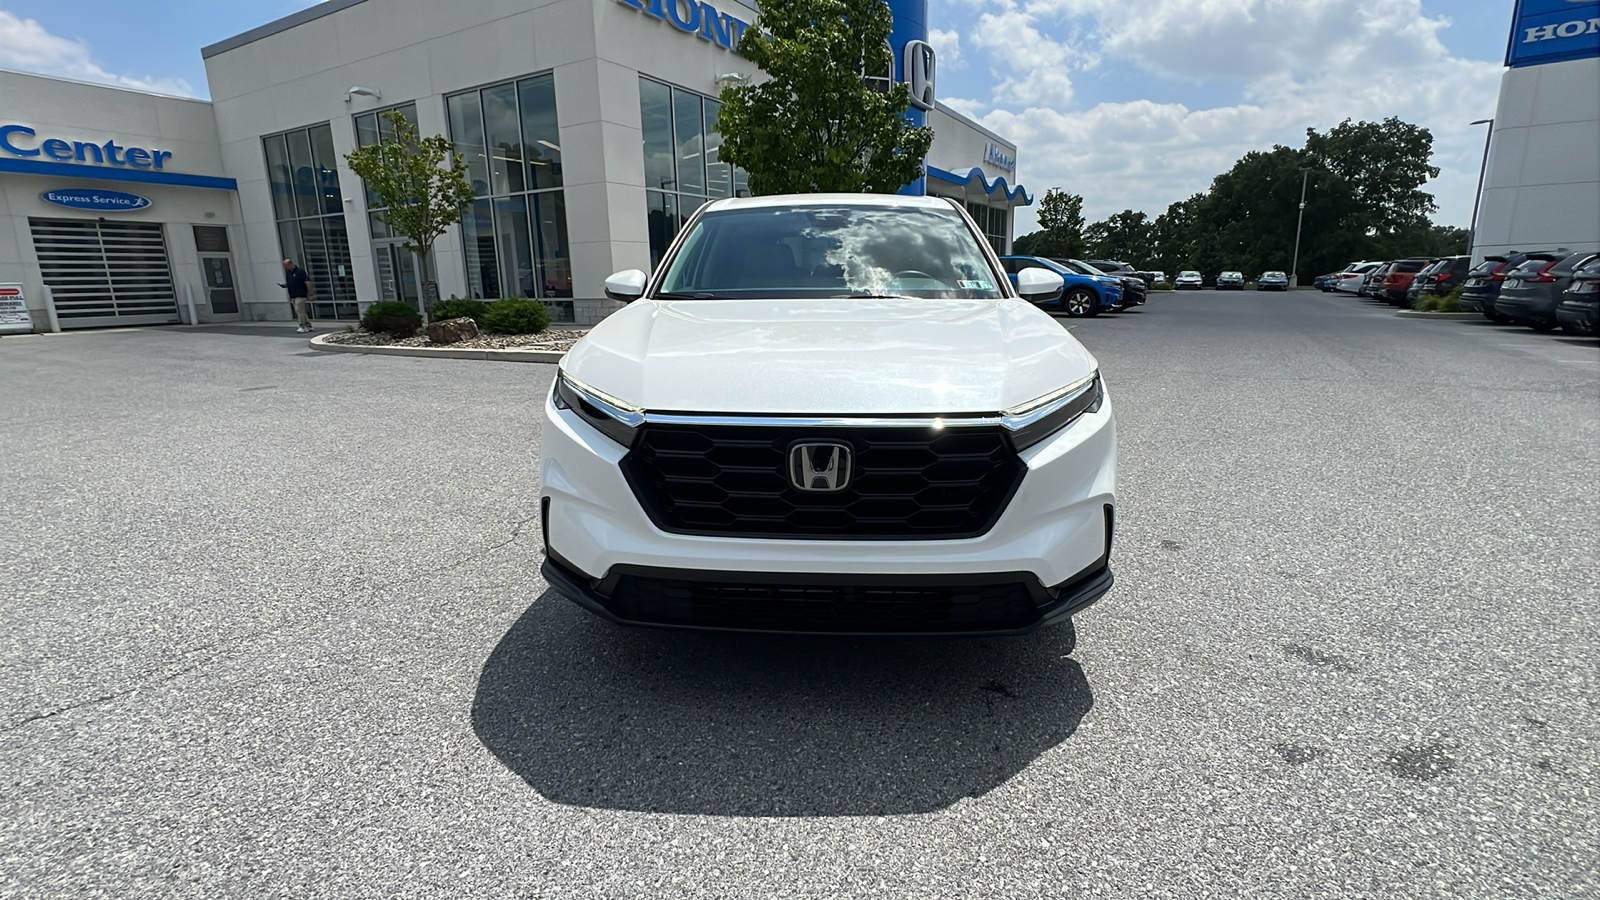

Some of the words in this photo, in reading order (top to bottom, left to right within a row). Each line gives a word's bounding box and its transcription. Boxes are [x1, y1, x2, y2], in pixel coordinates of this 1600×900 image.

[0, 124, 172, 169] Center
[48, 193, 91, 203] Express
[92, 196, 131, 205] Service
